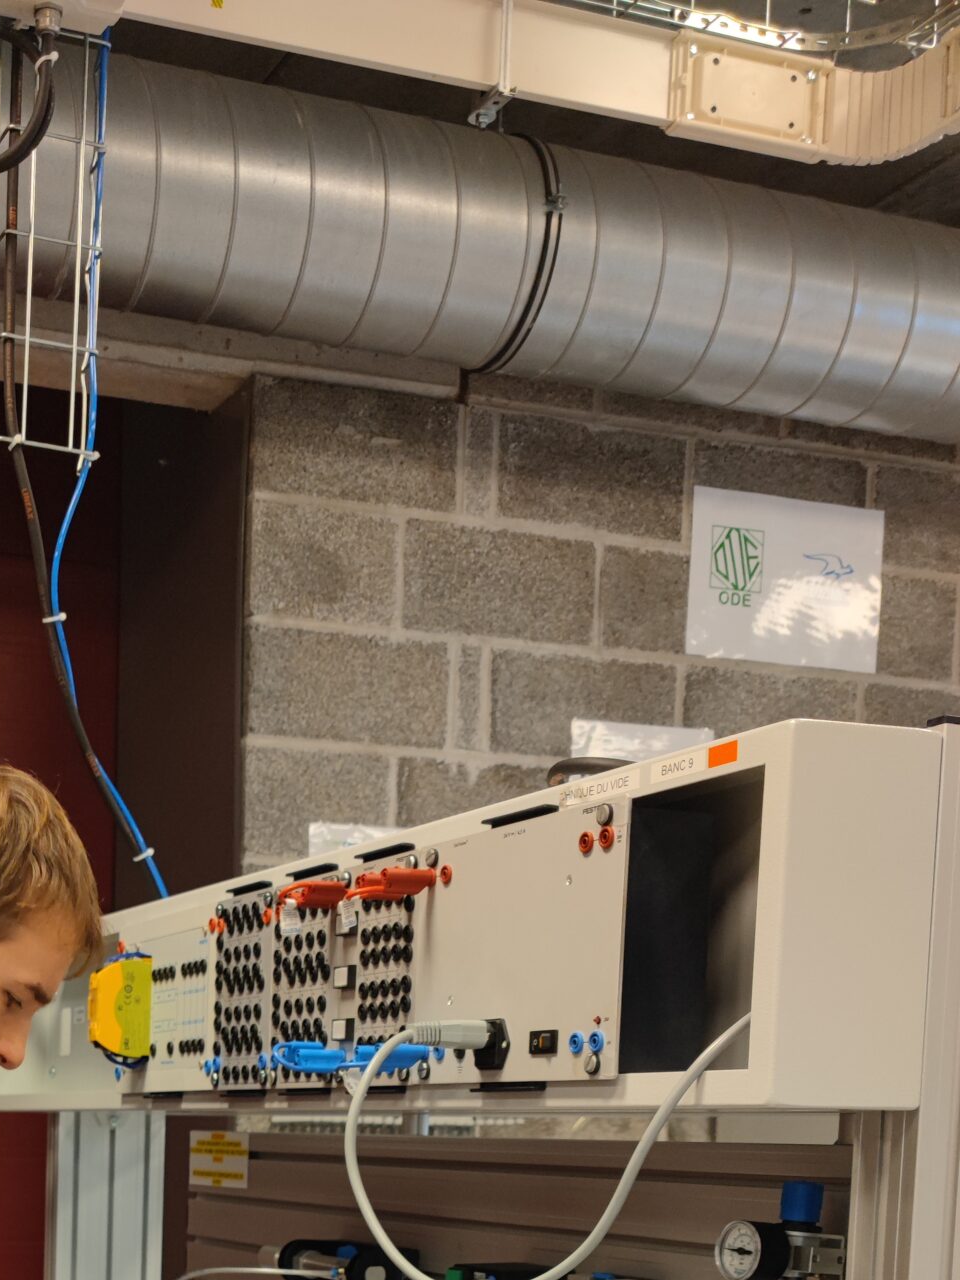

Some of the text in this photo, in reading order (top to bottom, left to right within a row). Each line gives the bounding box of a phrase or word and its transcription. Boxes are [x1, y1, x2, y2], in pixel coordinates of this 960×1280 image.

[719, 591, 751, 607] ODE
[661, 757, 694, 776] BANC 9
[597, 782, 609, 795] DU
[610, 775, 630, 791] VIDE
